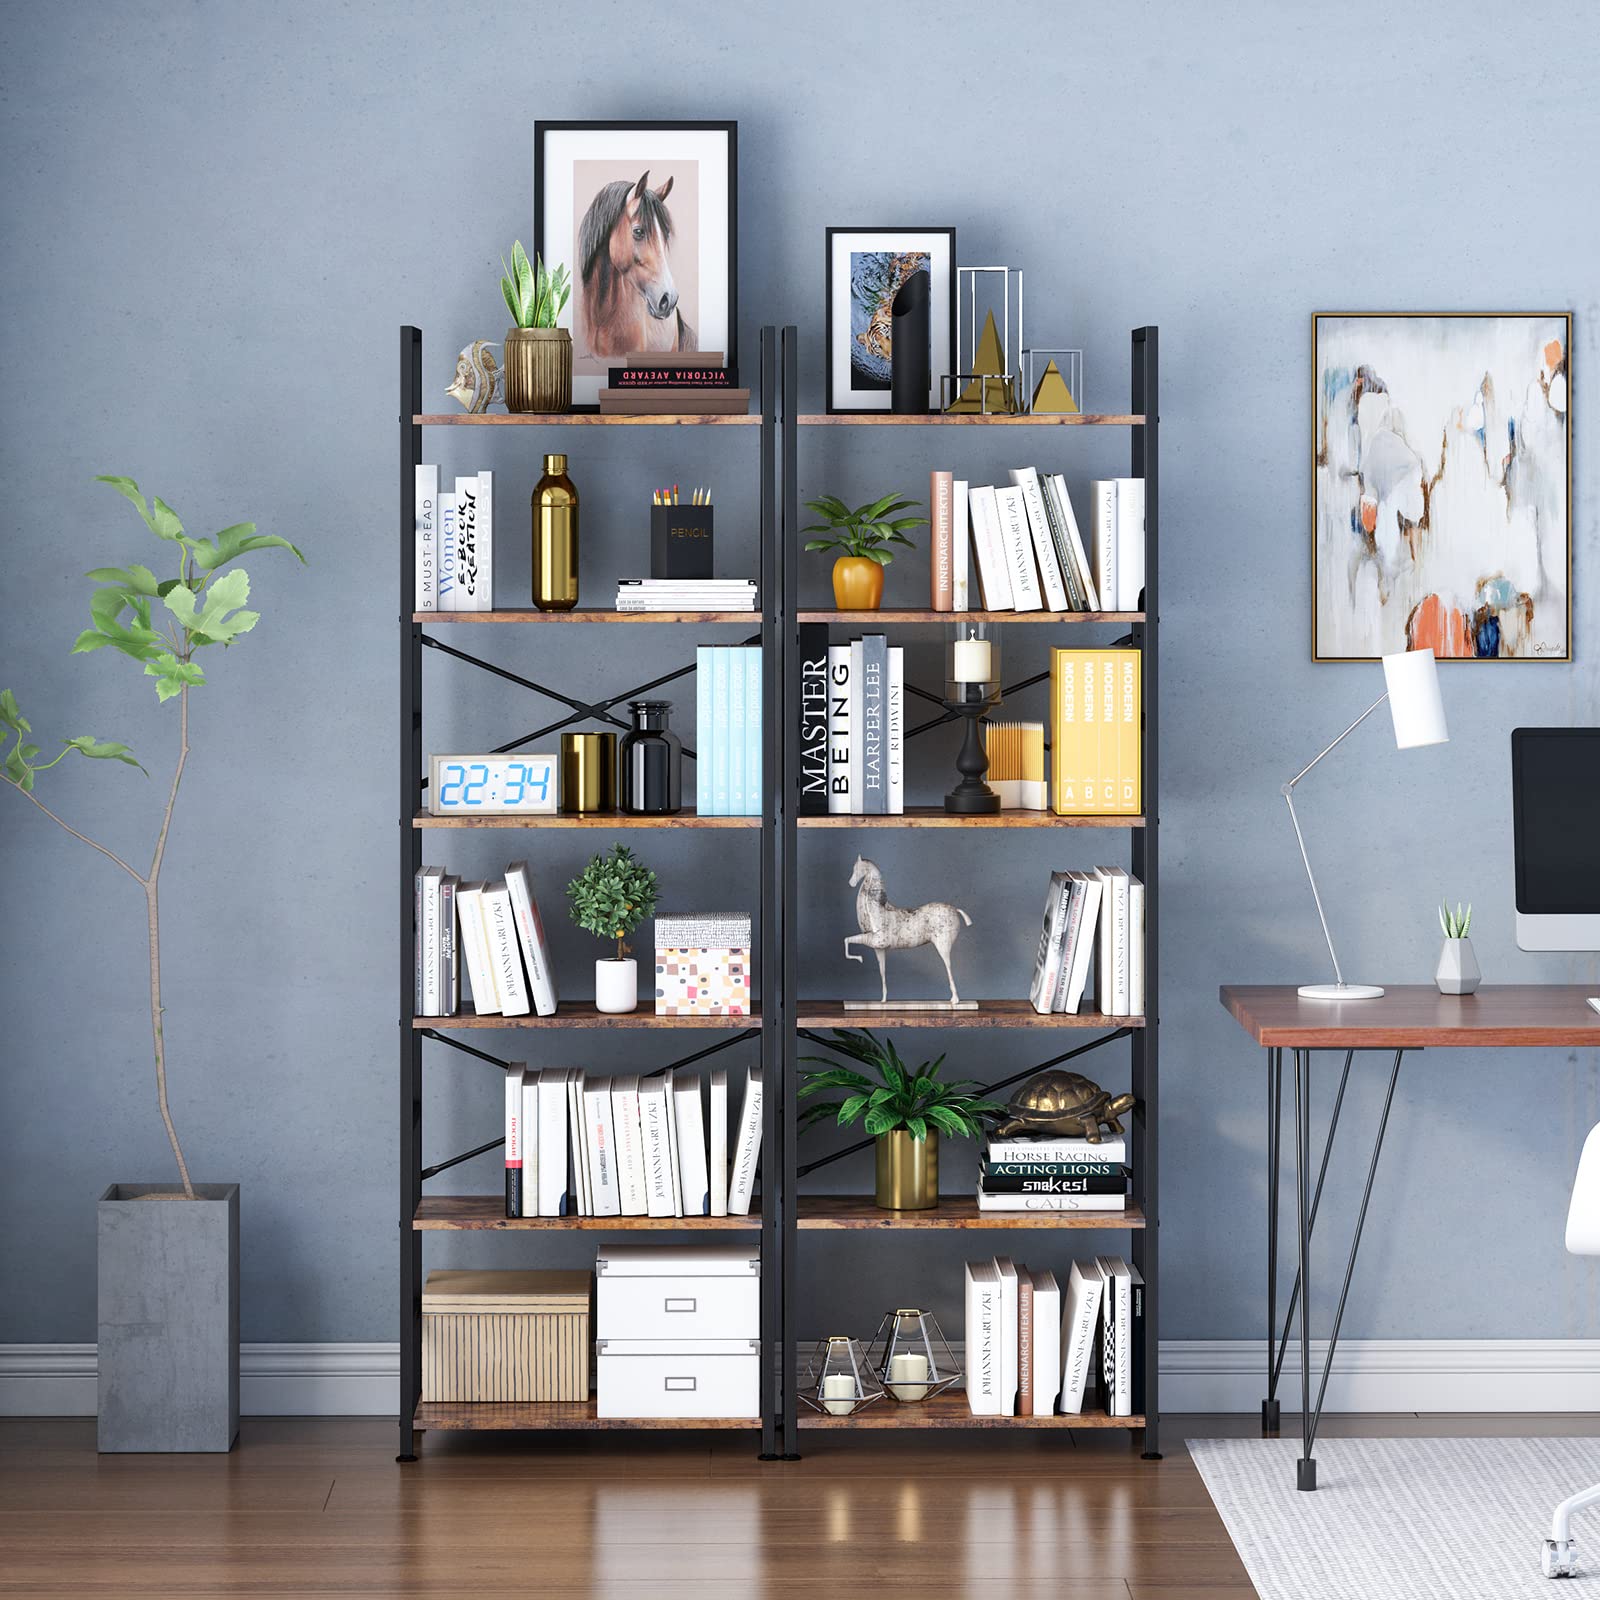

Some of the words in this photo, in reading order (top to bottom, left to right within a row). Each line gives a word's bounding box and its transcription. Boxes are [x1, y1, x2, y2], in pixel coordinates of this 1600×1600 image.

[623, 371, 669, 380] AVEYARD
[676, 371, 725, 380] VICTORIA
[423, 499, 432, 592] MUST-READ
[439, 509, 454, 596] Women
[458, 502, 468, 585] E-BOOK
[671, 528, 709, 538] PENCIL
[939, 479, 949, 592] INNENARCHITEKTUR
[866, 662, 880, 699] LEE
[1065, 662, 1074, 722] MODERN
[1084, 662, 1093, 722] MODERN
[1104, 662, 1113, 722] MODERN
[1124, 662, 1133, 722] MODERN
[801, 655, 827, 796] MASTER
[831, 664, 849, 794] BEING
[866, 703, 880, 789] HARPER
[441, 764, 550, 805] 22:34
[1065, 786, 1074, 799] A
[1085, 786, 1093, 799] B
[1104, 786, 1113, 799] C
[1124, 786, 1133, 799] D
[995, 1164, 1057, 1175] ACTING
[1063, 1164, 1110, 1175] LIONS
[1004, 1151, 1050, 1161] HORSE
[1055, 1151, 1108, 1162] RACING
[1021, 1177, 1088, 1193] snakes!
[1025, 1198, 1079, 1209] CATS
[1020, 1291, 1029, 1396] INNENARCHITEKTUR
